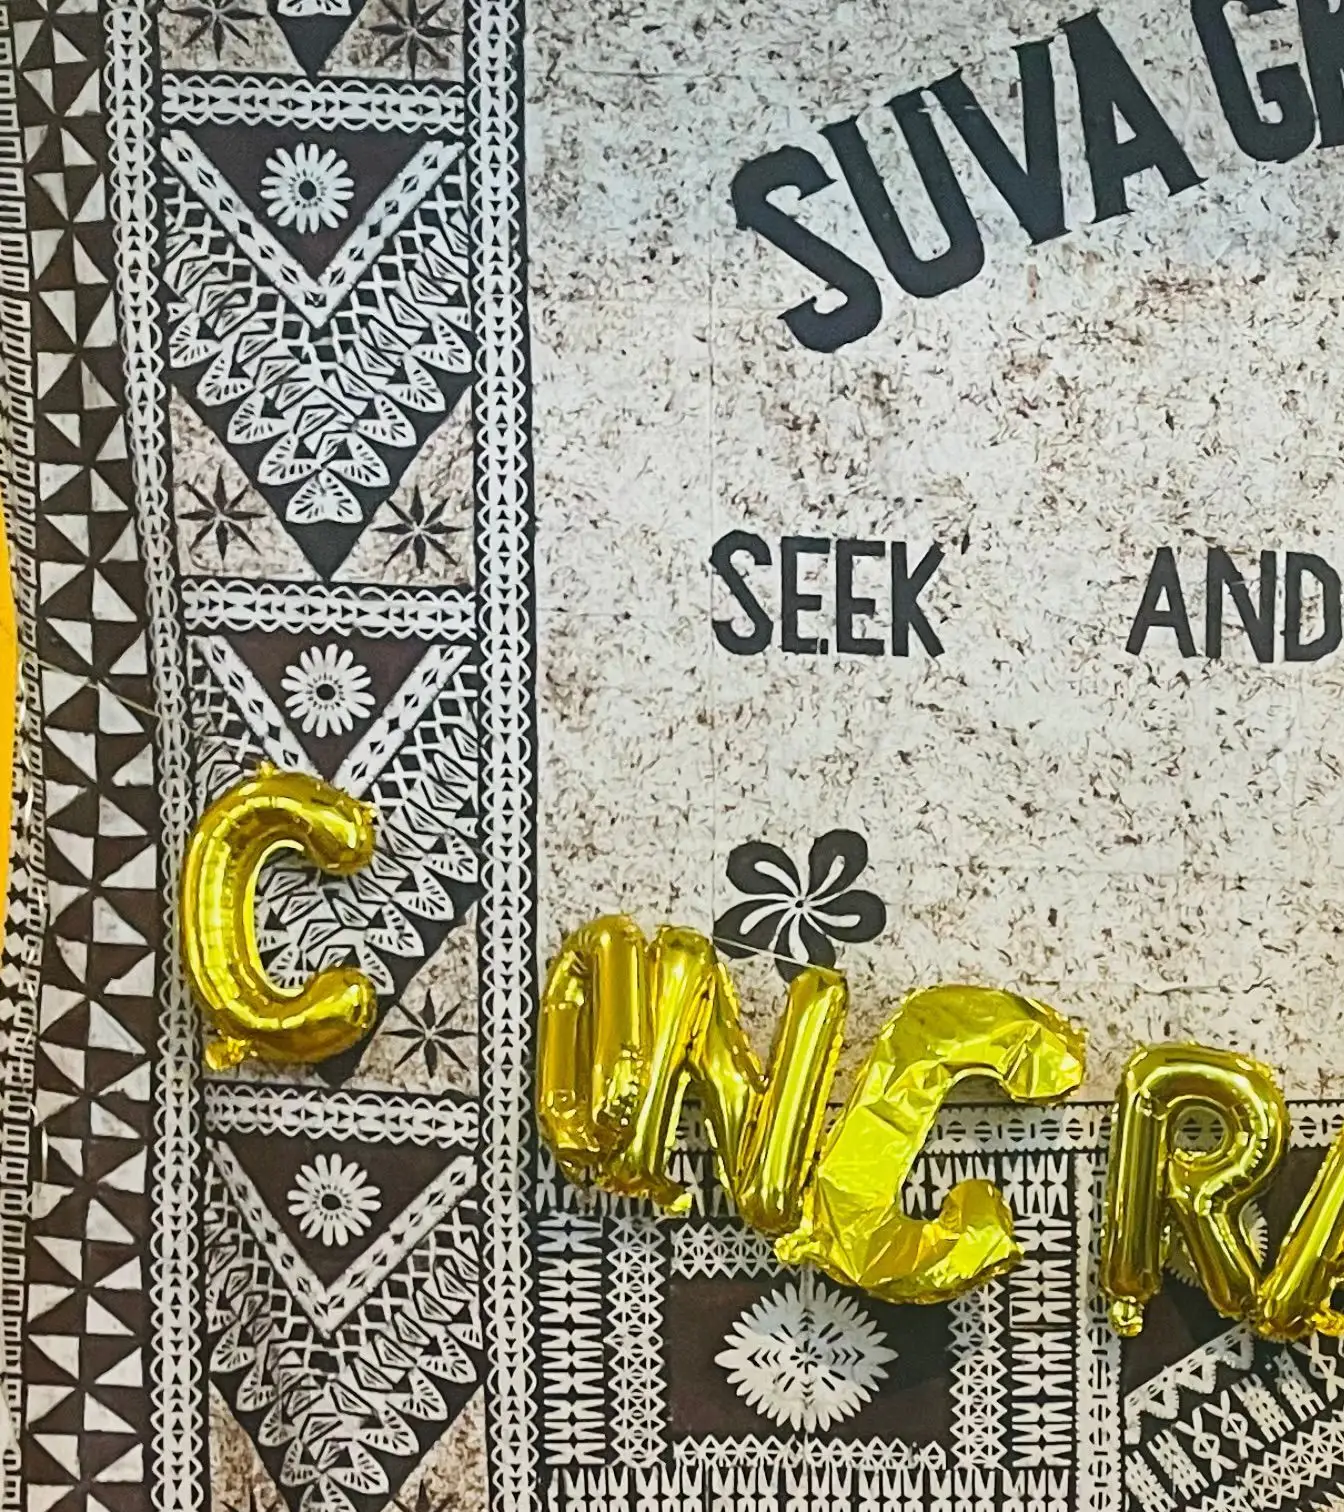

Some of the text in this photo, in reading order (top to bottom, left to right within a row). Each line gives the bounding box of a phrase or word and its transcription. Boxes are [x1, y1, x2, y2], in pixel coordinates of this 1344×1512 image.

[728, 10, 1207, 353] SUVA
[710, 528, 949, 661] SEEK
[1125, 546, 1342, 664] AND
